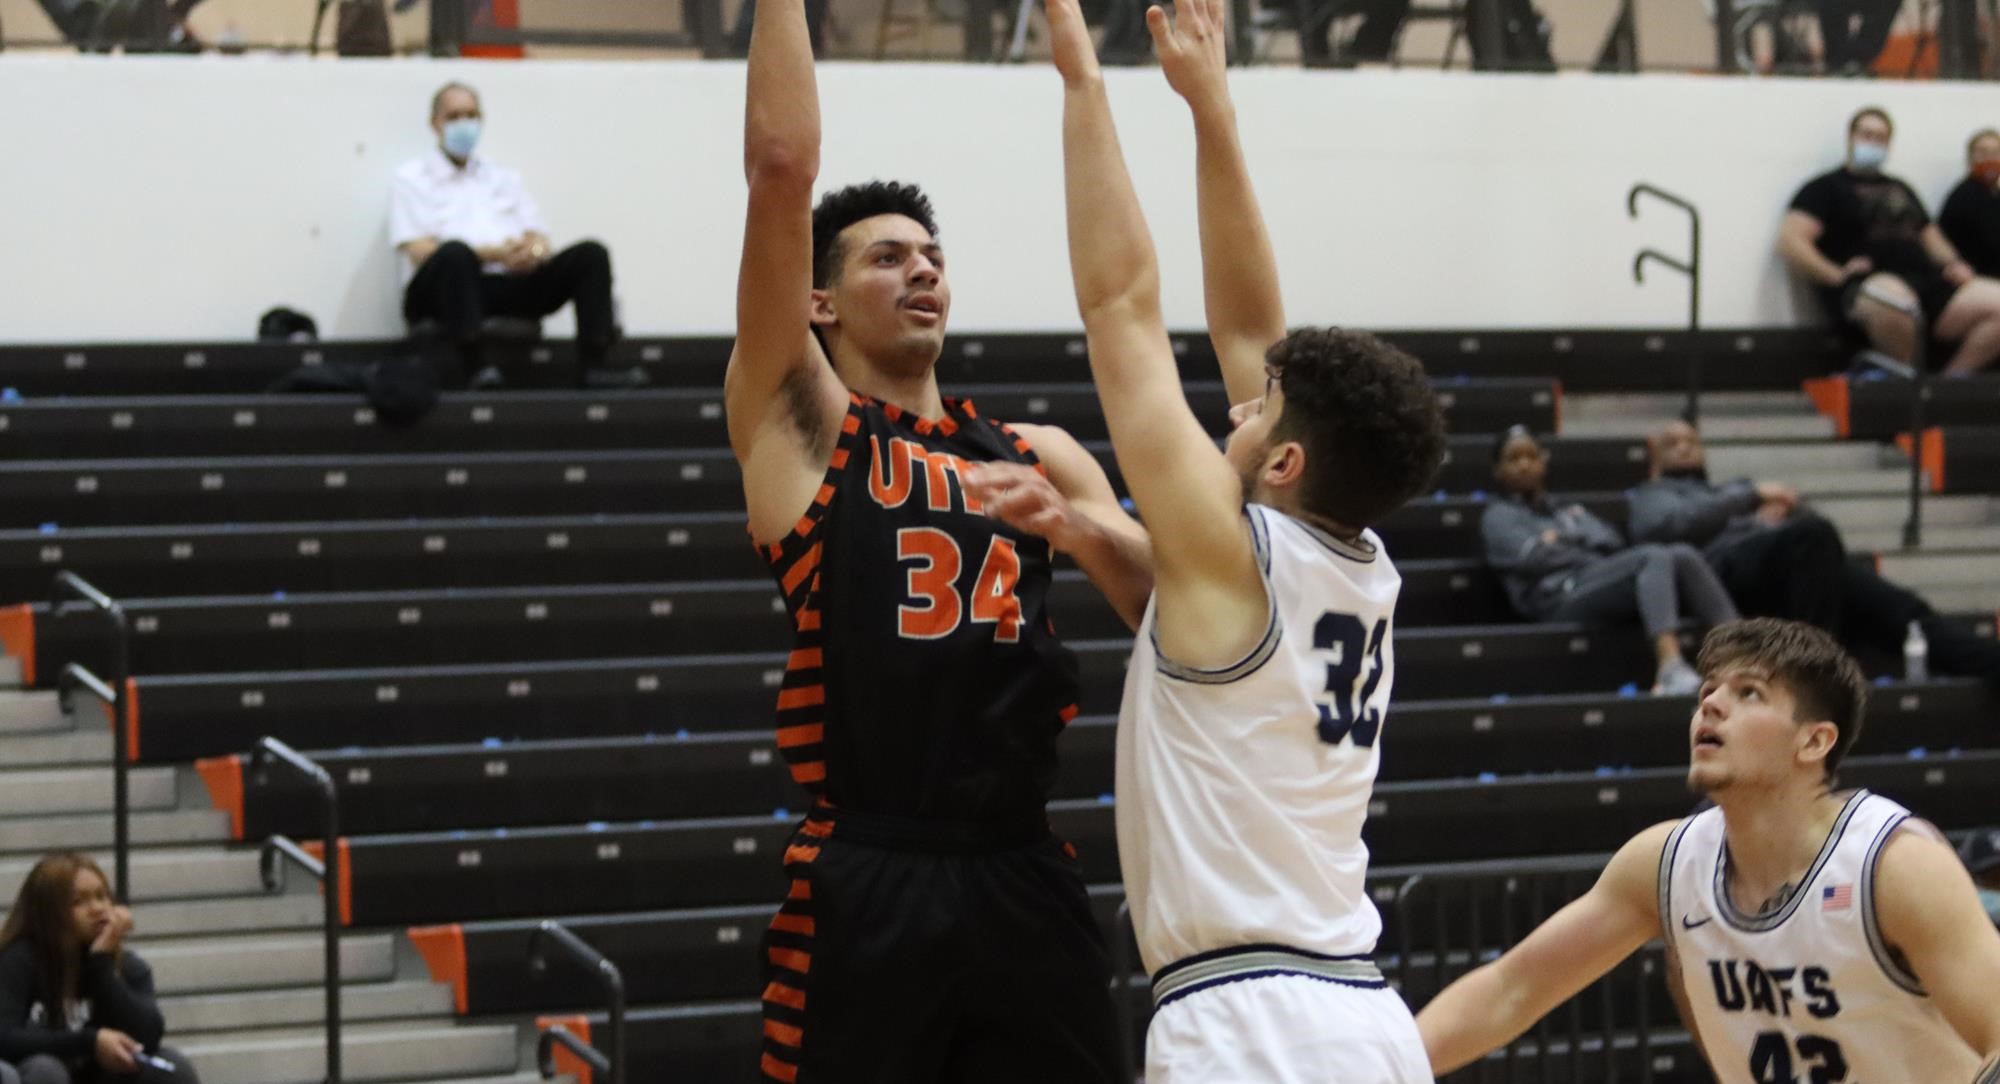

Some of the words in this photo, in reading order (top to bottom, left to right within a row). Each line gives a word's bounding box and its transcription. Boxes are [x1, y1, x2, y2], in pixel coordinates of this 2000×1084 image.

[897, 527, 1025, 643] 34
[1313, 612, 1387, 748] 32
[1708, 960, 1841, 1018] UAFS
[1750, 1031, 1855, 1084] 42
